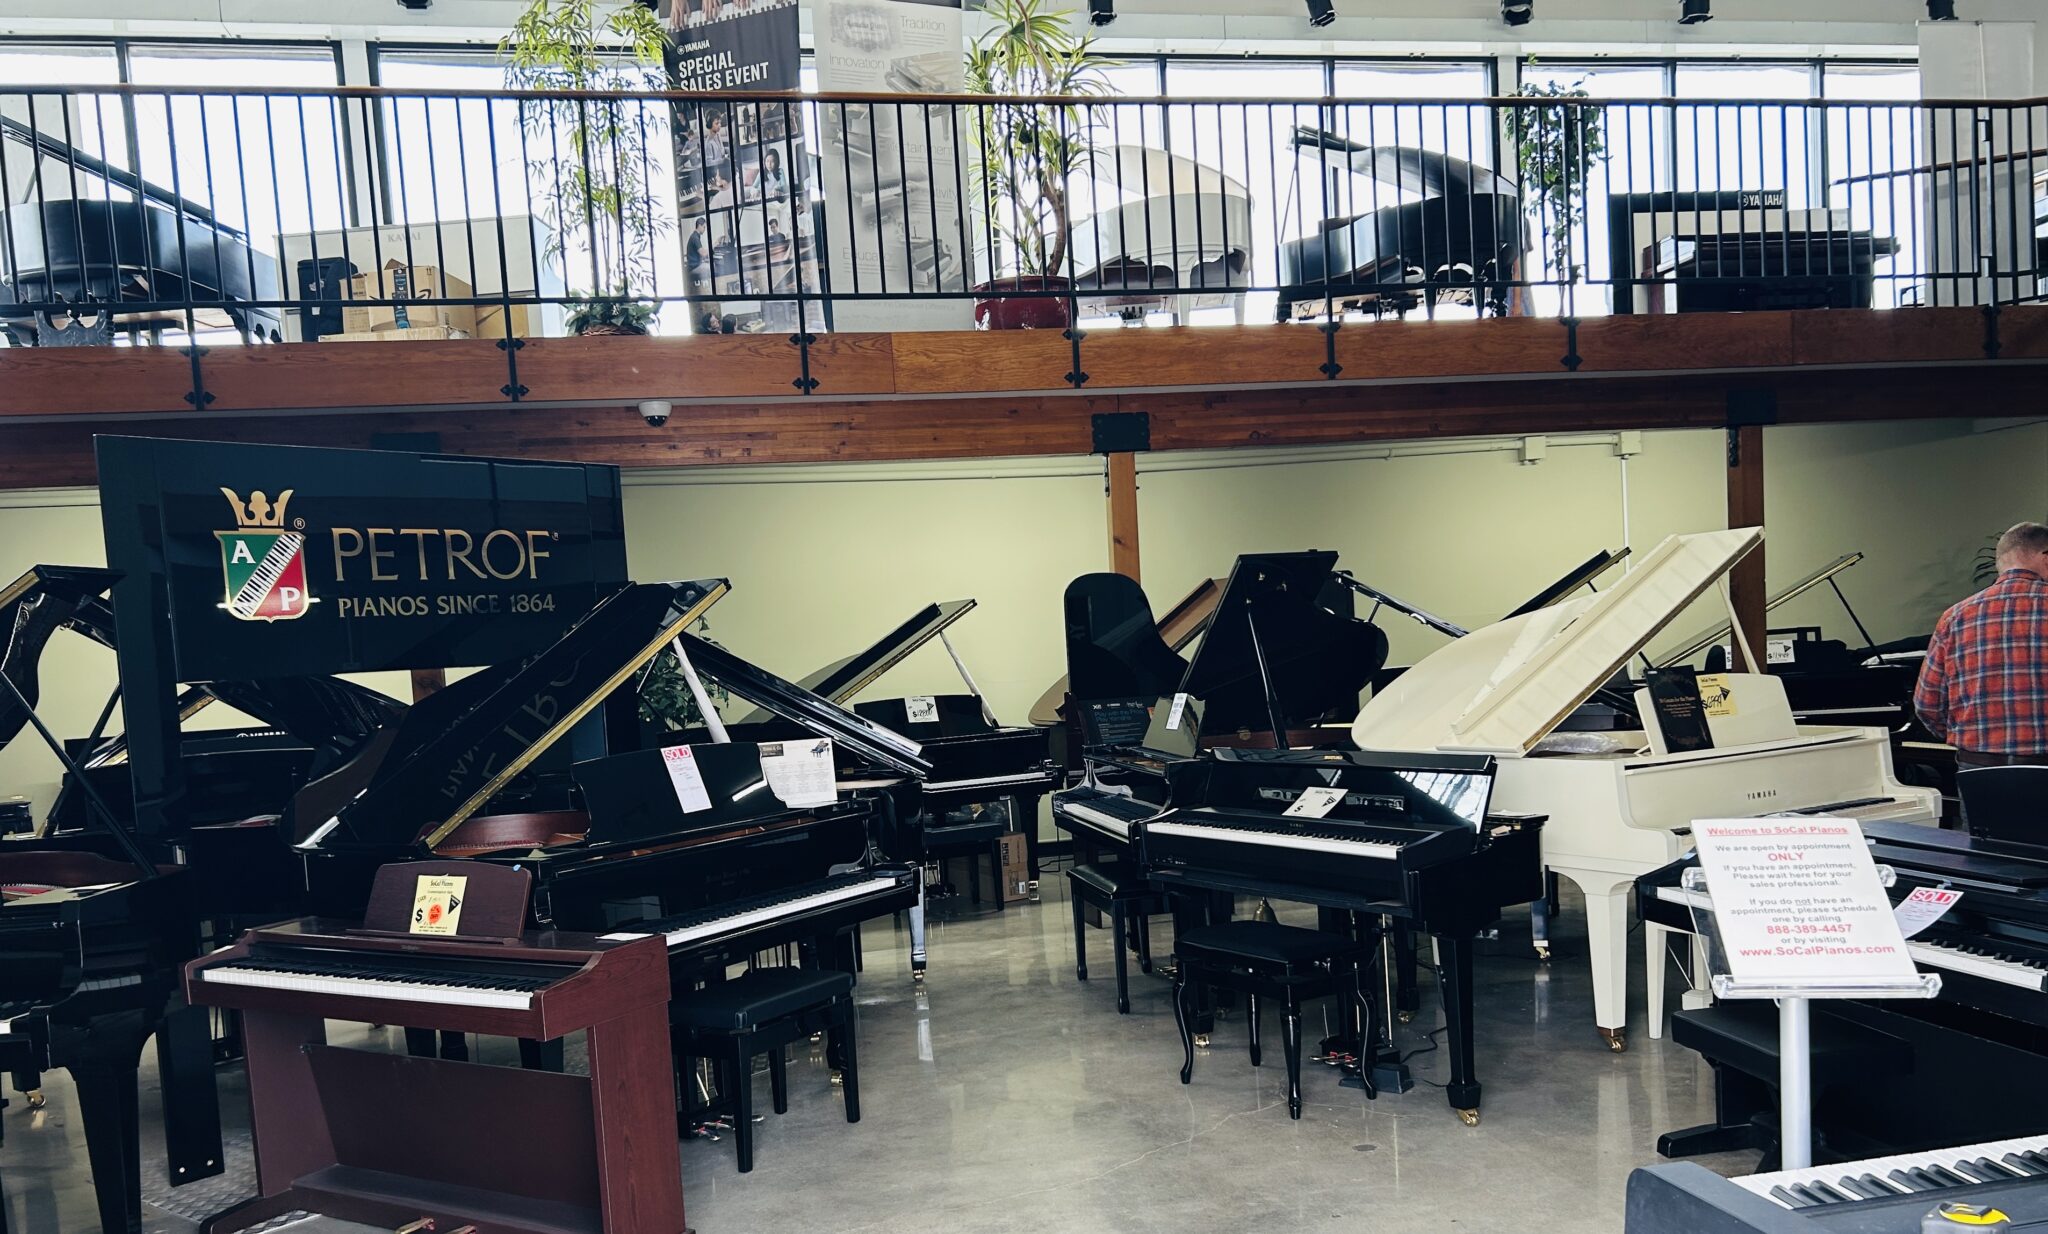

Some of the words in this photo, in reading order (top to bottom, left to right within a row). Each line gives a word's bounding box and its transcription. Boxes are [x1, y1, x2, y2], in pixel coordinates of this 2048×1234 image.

[901, 15, 946, 31] Tradition
[685, 40, 710, 53] YAMAHA
[678, 50, 735, 80] SPECIAL
[829, 53, 885, 70] Innovation
[680, 71, 723, 92] SALES
[725, 62, 769, 88] EVENT
[388, 231, 421, 242] KAAI
[231, 540, 256, 564] A
[279, 587, 300, 611] P
[338, 596, 428, 618] PIANOS
[437, 594, 501, 616] SINCE
[510, 593, 555, 613] 1864
[664, 748, 692, 761] SOLD
[1747, 789, 1777, 800] YAMAHA
[1707, 827, 1757, 835] Welcome
[1775, 826, 1807, 834] SoCal
[1810, 826, 1848, 834] Pianos
[1777, 844, 1789, 852] by
[1792, 843, 1851, 852] appointment
[1768, 852, 1804, 861] ONLY
[1789, 871, 1810, 879] here
[1829, 871, 1851, 879] your
[1910, 890, 1957, 905] SOLD
[1797, 906, 1829, 914] please
[1793, 915, 1805, 924] by
[1808, 915, 1841, 923] calling
[1767, 924, 1852, 934] 888-389-4457
[1794, 936, 1807, 945] by
[1809, 935, 1846, 944] visiting
[1740, 945, 1895, 957] www.SoCalPianos.com
